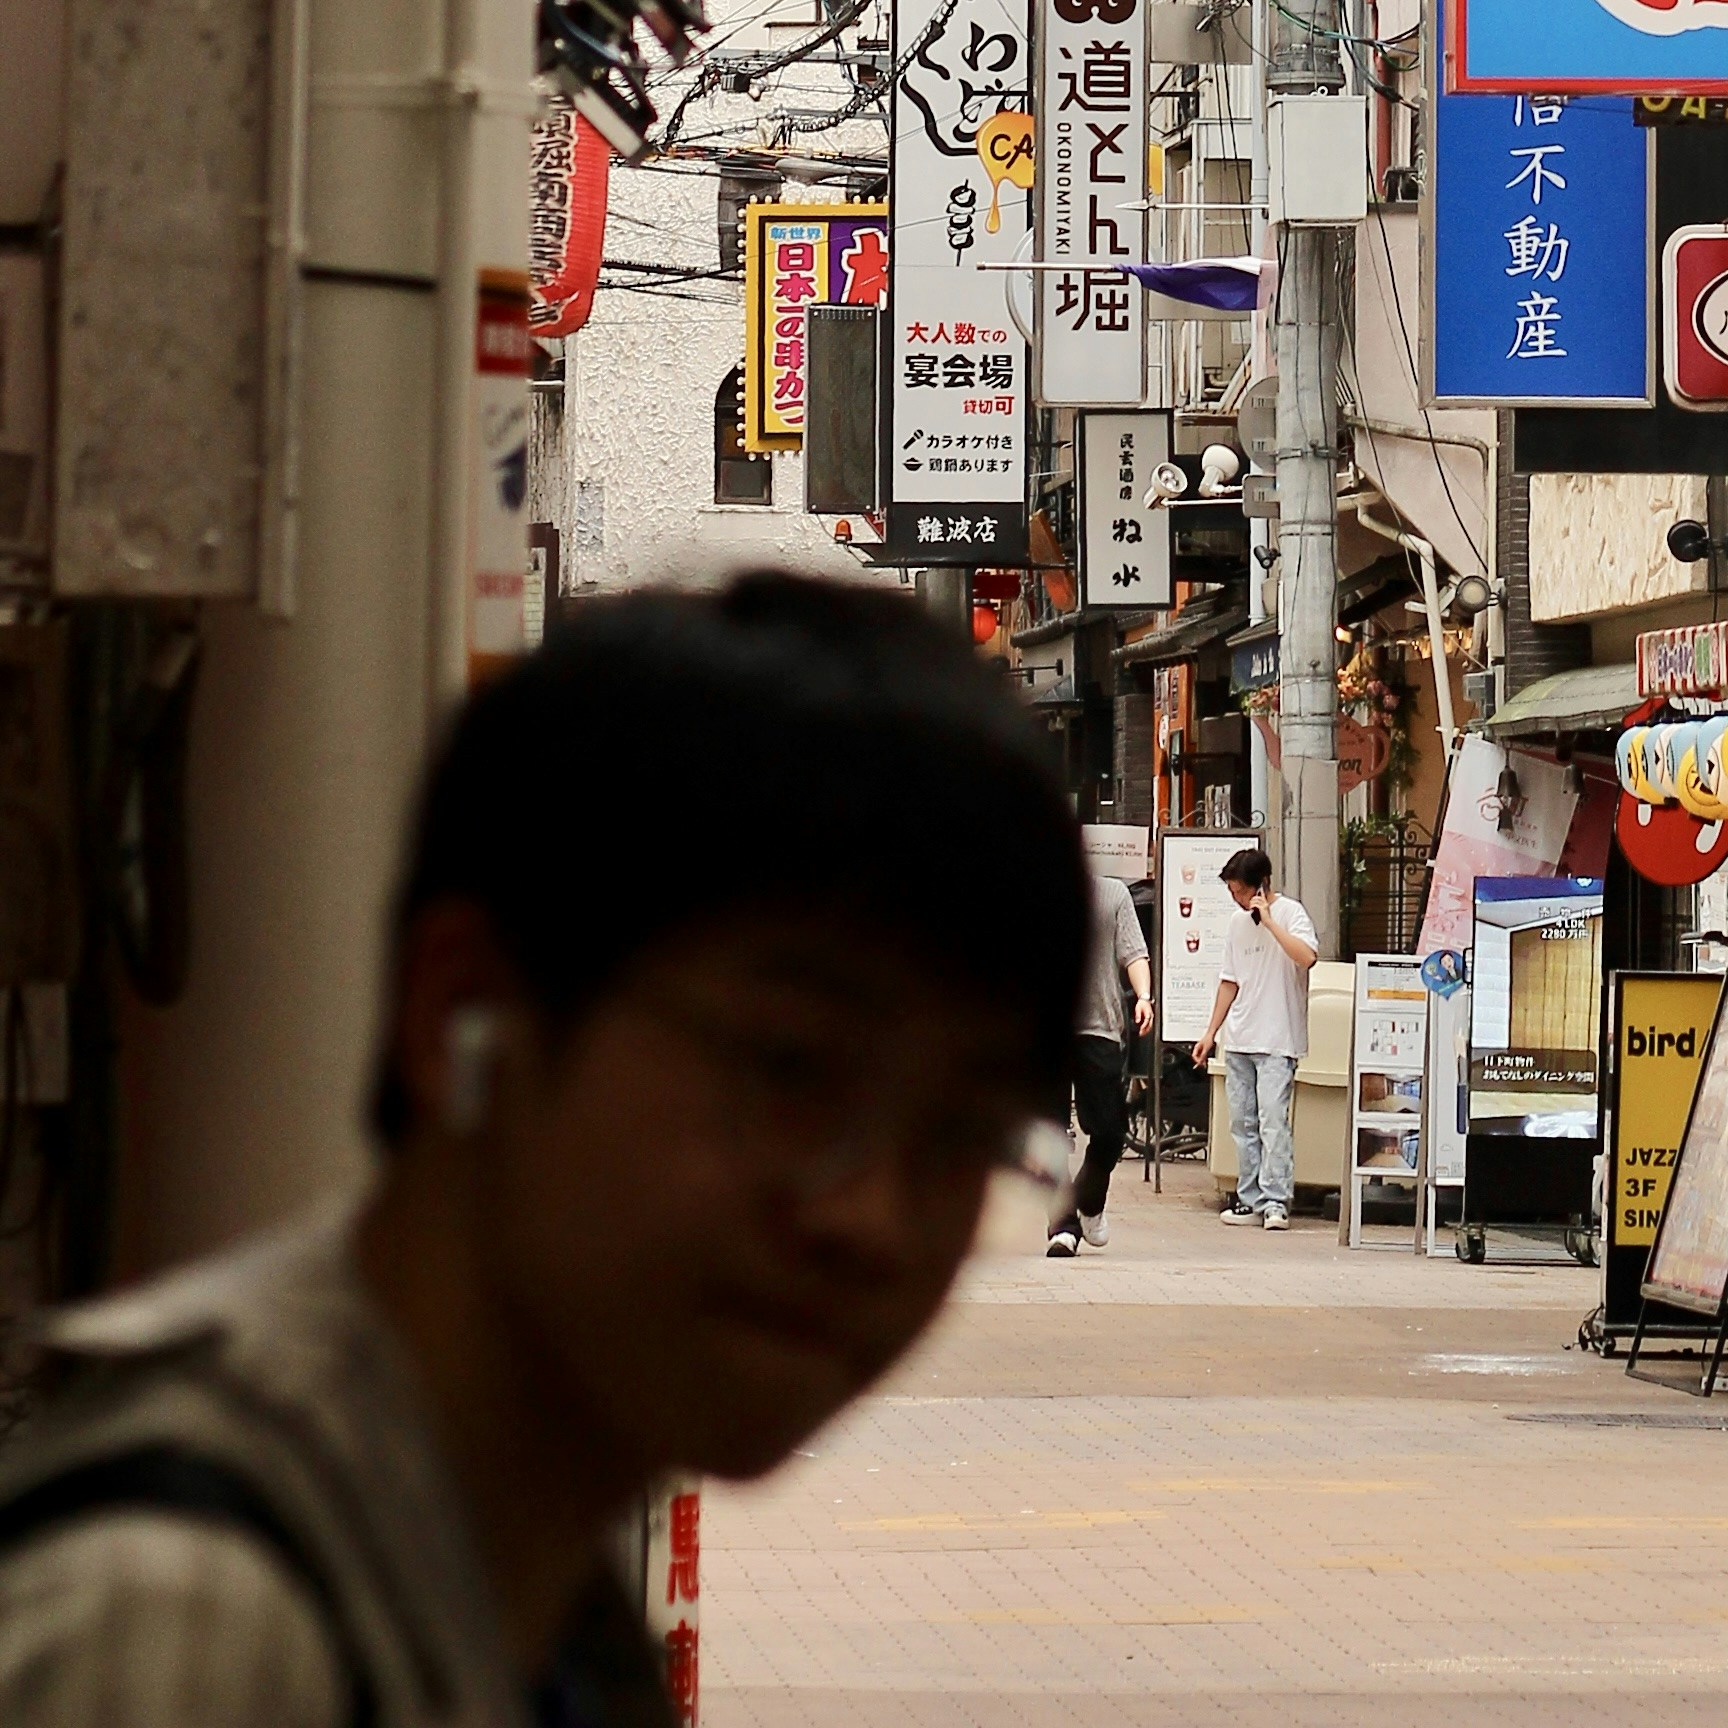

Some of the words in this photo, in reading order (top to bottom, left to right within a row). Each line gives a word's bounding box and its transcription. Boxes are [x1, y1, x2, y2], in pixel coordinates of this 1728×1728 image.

[1056, 40, 1131, 332] 道とん堀
[1056, 121, 1072, 256] OKONOMIYAKI
[906, 321, 1008, 345] 大人数での
[903, 353, 1014, 389] 宴会場
[962, 395, 1015, 416] 貸切可
[926, 434, 1013, 450] カラオケ付き
[916, 515, 999, 544] 難波店
[1625, 1178, 1657, 1198] 3F
